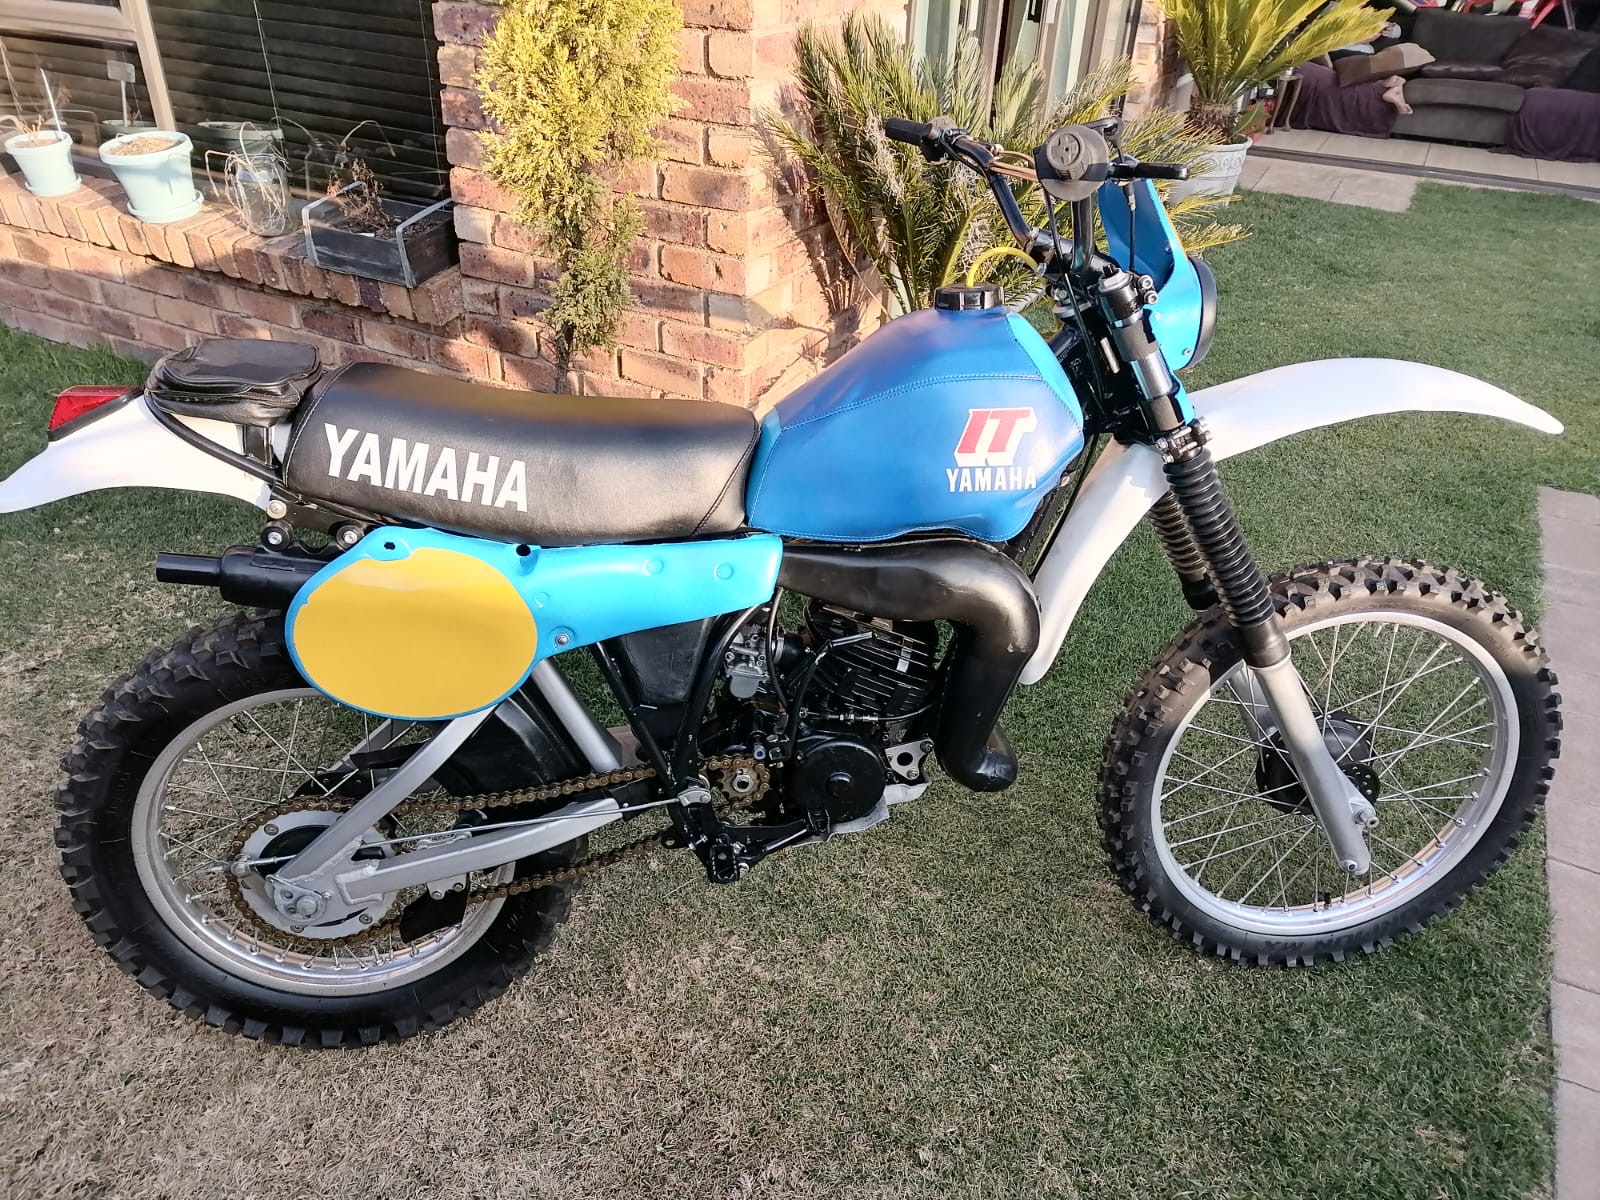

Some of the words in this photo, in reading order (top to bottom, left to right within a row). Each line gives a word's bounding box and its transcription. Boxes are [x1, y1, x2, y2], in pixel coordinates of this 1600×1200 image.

[324, 422, 528, 513] YAMAHA
[953, 406, 1038, 468] IT
[945, 466, 1038, 493] YAMAHA
